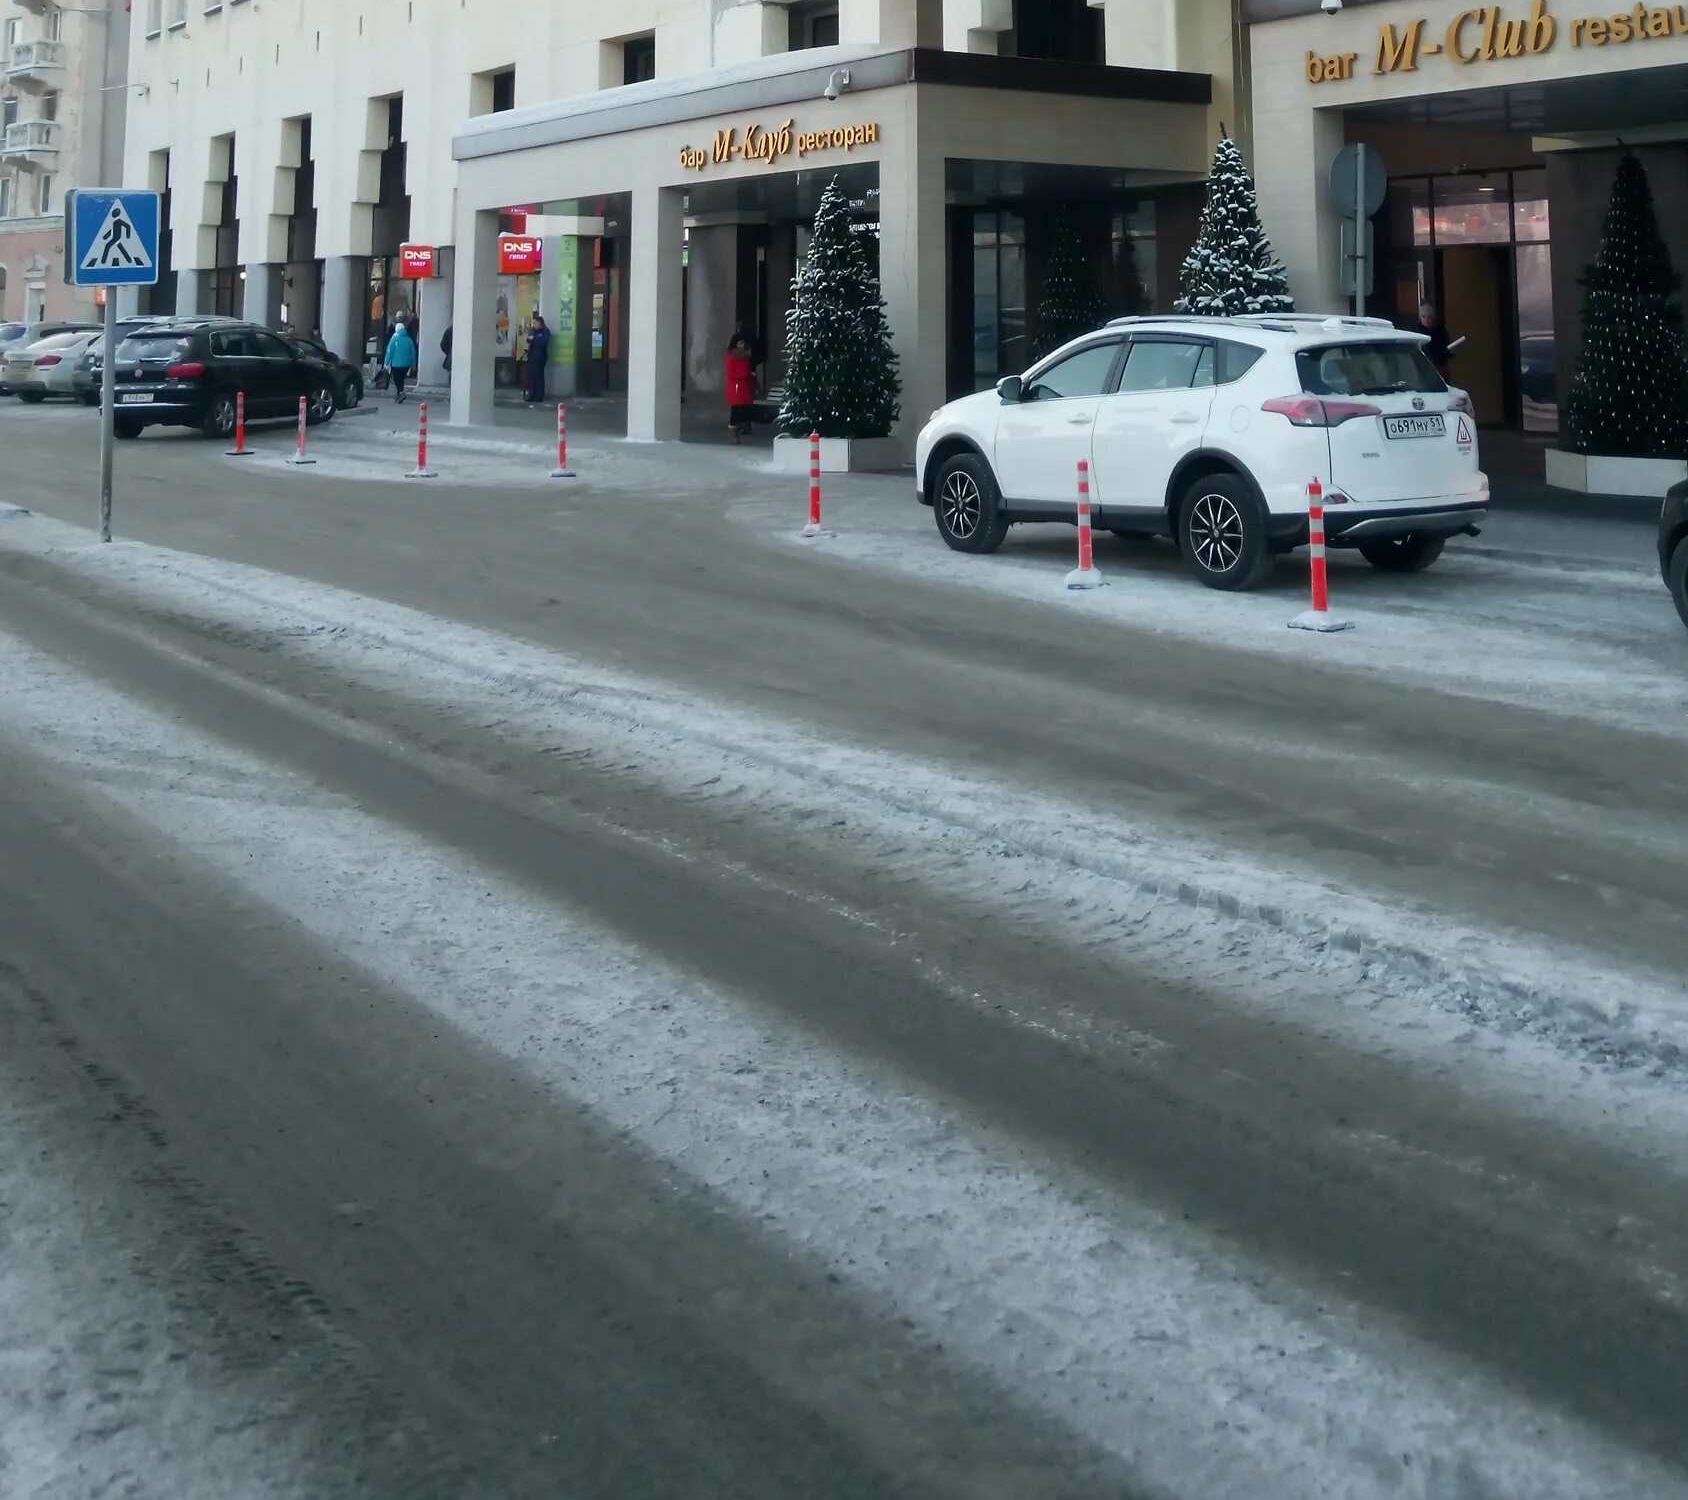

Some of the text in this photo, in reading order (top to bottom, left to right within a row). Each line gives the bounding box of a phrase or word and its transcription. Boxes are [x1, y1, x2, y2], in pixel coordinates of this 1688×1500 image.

[1305, 50, 1357, 83] bar
[680, 118, 880, 171] бар М-Клуб ресторан
[404, 251, 431, 260] DNS
[503, 243, 533, 252] DNS
